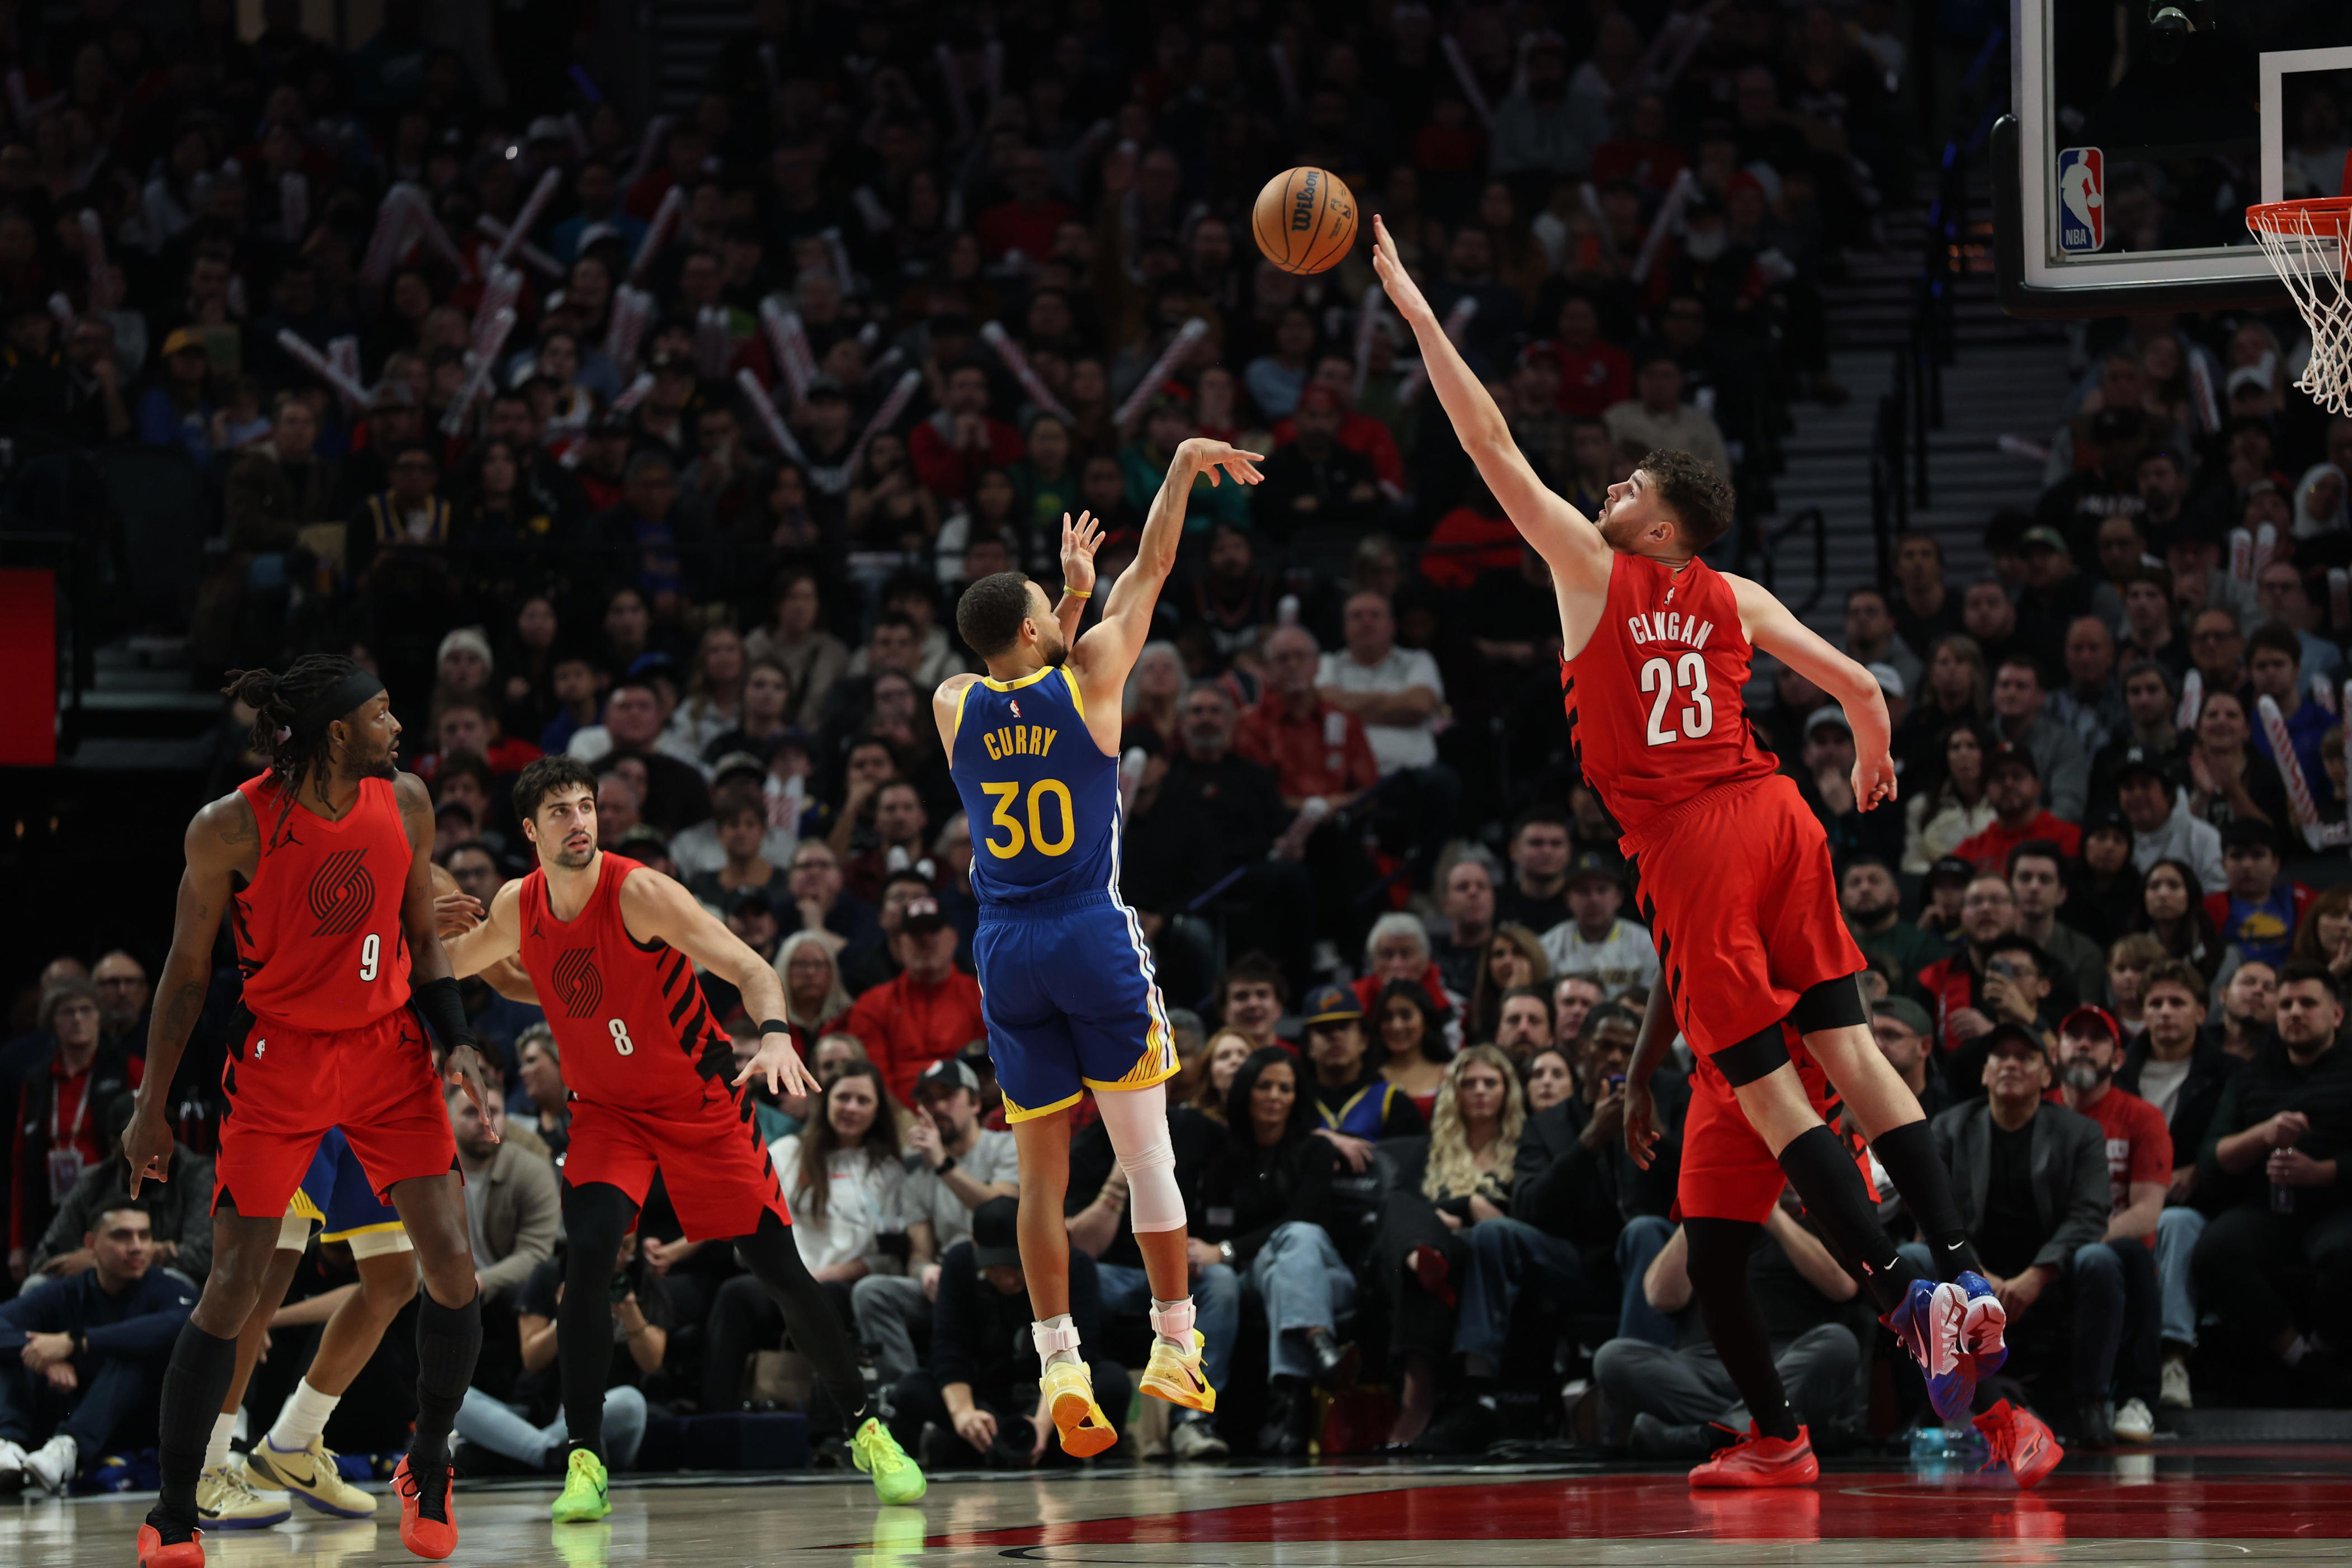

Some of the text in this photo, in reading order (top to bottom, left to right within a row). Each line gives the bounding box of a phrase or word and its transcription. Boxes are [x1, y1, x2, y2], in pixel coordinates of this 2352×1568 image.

[1292, 170, 1320, 232] Wilson
[2066, 228, 2087, 245] NBA
[1641, 652, 1713, 747] 23
[983, 725, 1057, 761] CURRY
[980, 778, 1075, 859] 30
[359, 933, 381, 982] 9
[608, 1018, 635, 1056] 8
